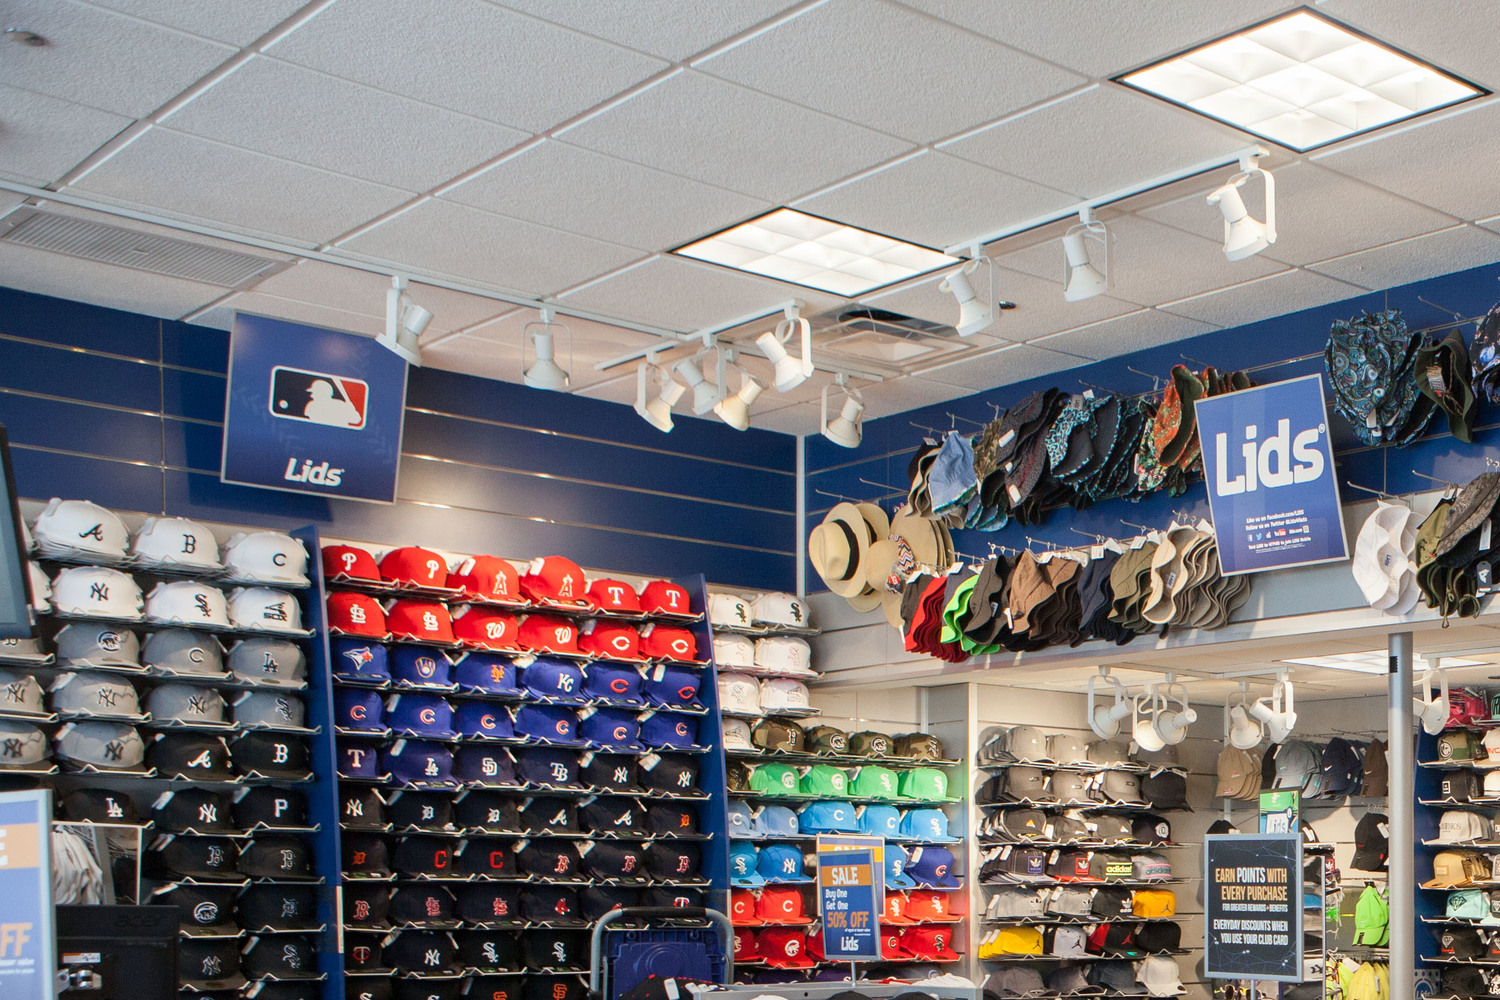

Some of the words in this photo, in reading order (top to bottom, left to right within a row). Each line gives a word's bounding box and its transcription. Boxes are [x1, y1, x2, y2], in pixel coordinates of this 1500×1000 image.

[1216, 418, 1325, 497] Lids
[284, 458, 342, 486] Lids
[182, 534, 197, 554] B
[272, 553, 287, 567] C
[832, 867, 859, 885] SALE
[1215, 868, 1235, 883] EARN
[1237, 867, 1265, 883] POINTS
[1267, 868, 1287, 883] WITH
[825, 889, 836, 900] Buy
[837, 890, 847, 898] One
[1221, 886, 1246, 900] EVERY
[1247, 886, 1288, 901] PURCHASE
[826, 901, 835, 910] Get
[837, 902, 848, 910] One
[827, 911, 847, 928] 50%
[851, 911, 869, 928] OFF
[1214, 919, 1240, 930] EVERYDAY
[1241, 920, 1271, 931] DISCOUNTS
[1272, 921, 1288, 931] WHEN
[0, 922, 33, 958] FF
[841, 937, 859, 951] Lids
[1221, 933, 1231, 943] YOU
[1232, 933, 1242, 943] USE
[1243, 933, 1257, 944] YOUR
[1258, 934, 1272, 945] CLUB
[1273, 934, 1288, 945] CARD
